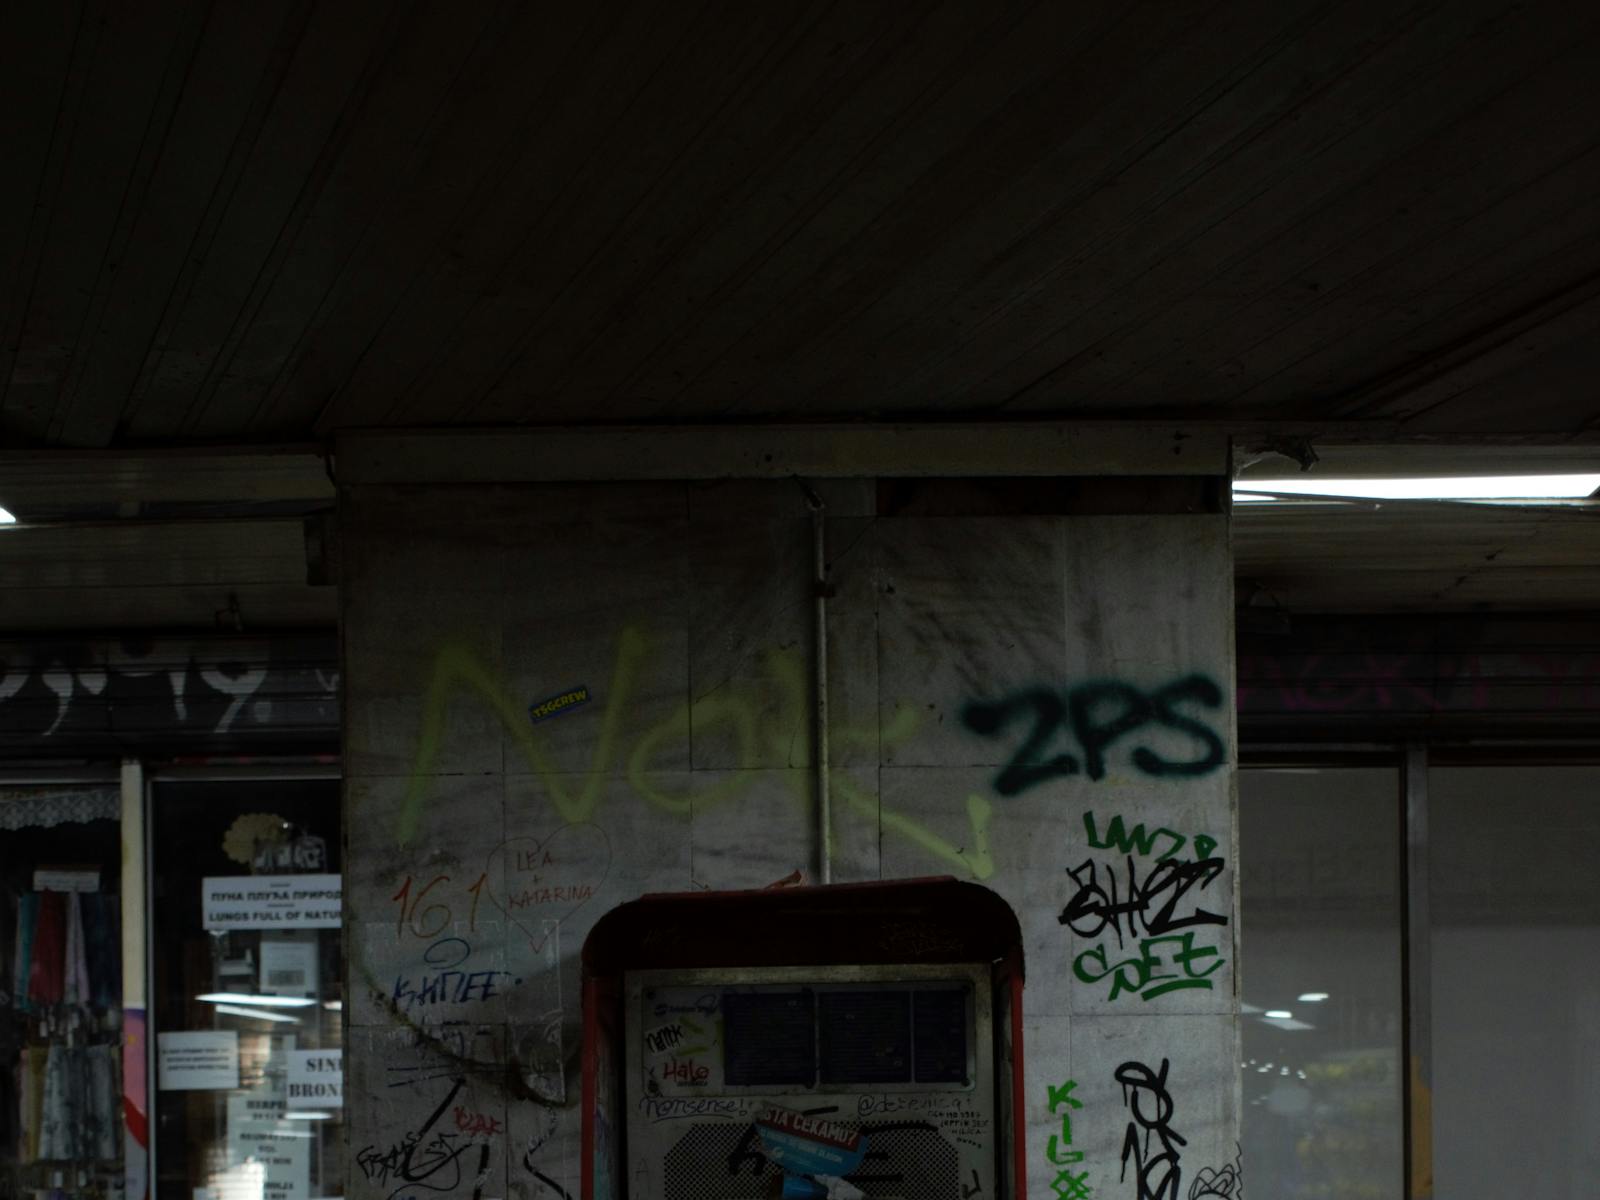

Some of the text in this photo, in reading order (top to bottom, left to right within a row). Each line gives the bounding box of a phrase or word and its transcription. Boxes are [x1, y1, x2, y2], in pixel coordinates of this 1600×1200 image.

[517, 850, 553, 872] LEA
[509, 886, 594, 910] KATARINA
[209, 912, 249, 922] LUNGS
[253, 911, 283, 921] FULL
[285, 911, 301, 920] OF
